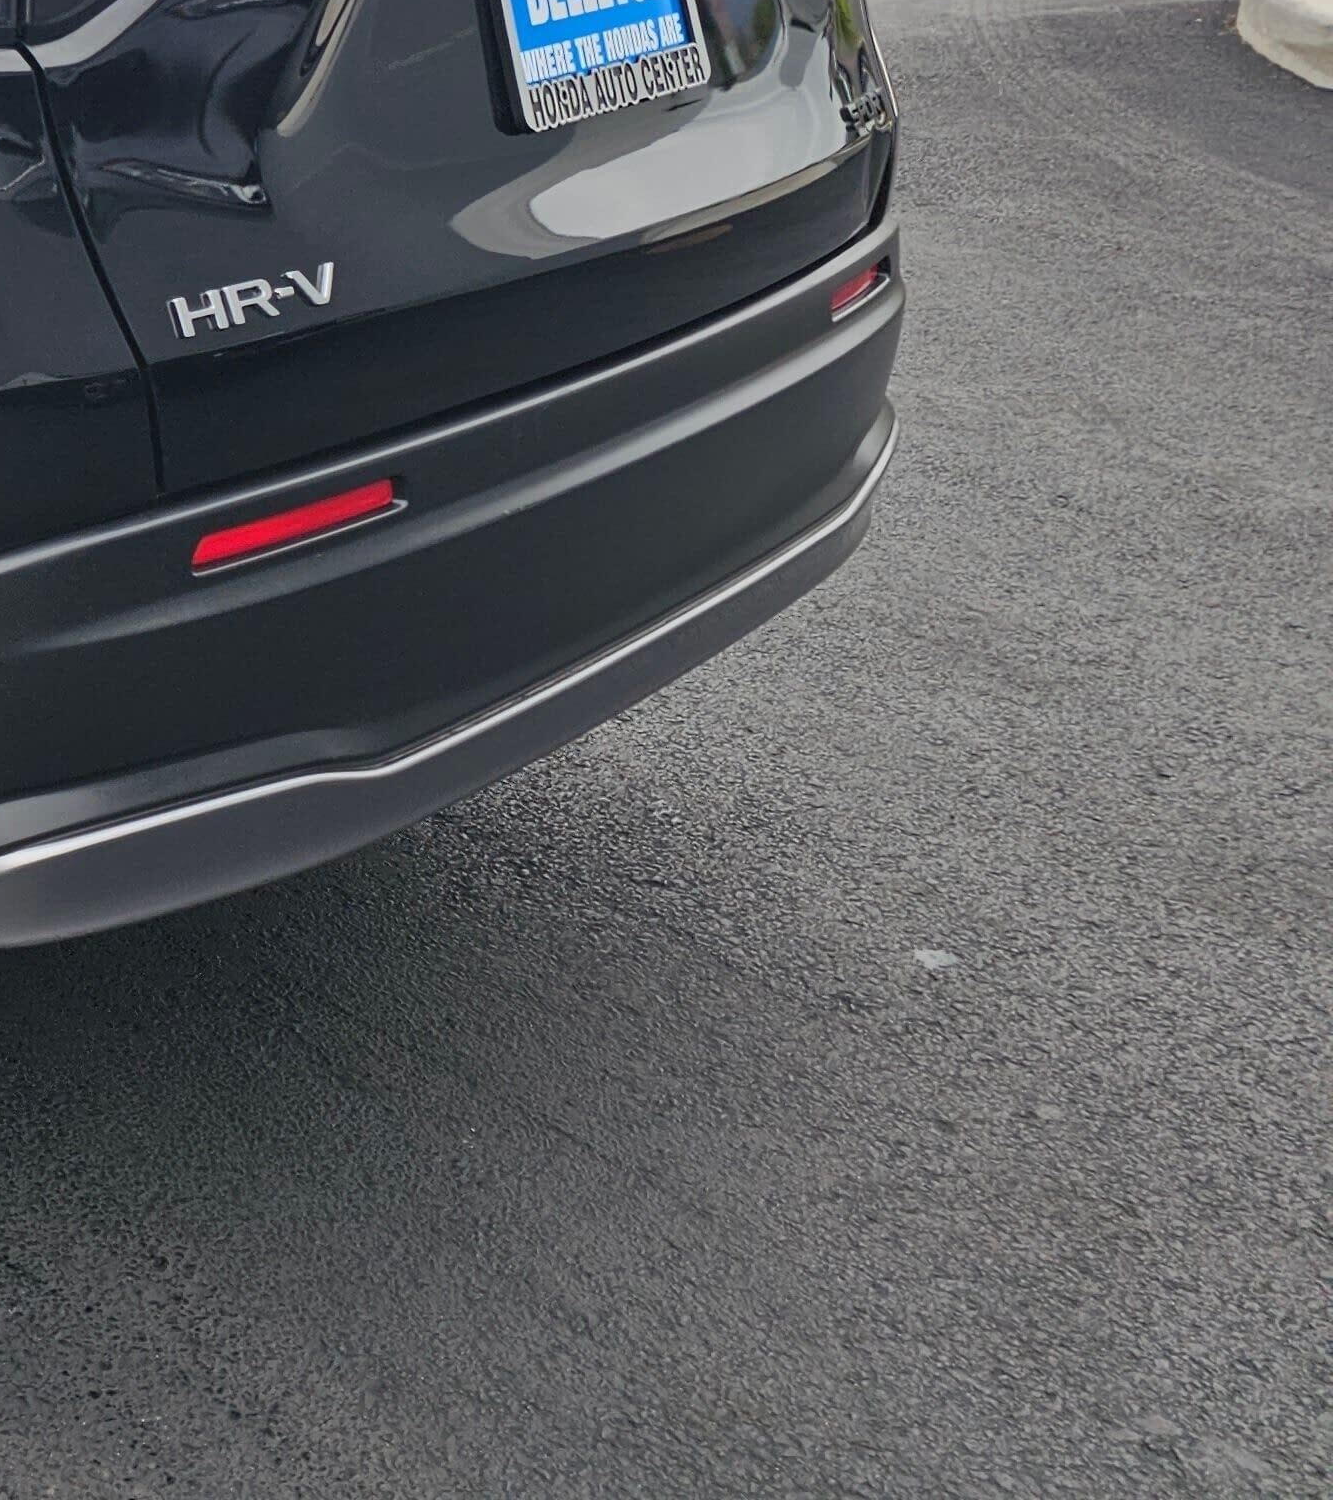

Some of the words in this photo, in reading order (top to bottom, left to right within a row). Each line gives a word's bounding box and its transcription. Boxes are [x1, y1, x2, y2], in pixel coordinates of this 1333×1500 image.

[520, 40, 576, 83] WHERE
[574, 32, 605, 69] THE
[603, 19, 660, 62] HONDAS
[658, 12, 685, 48] ARE
[529, 73, 592, 129] HONDA
[595, 61, 638, 112] AUTO
[640, 46, 706, 98] CENTER
[166, 261, 334, 338] HR-V
